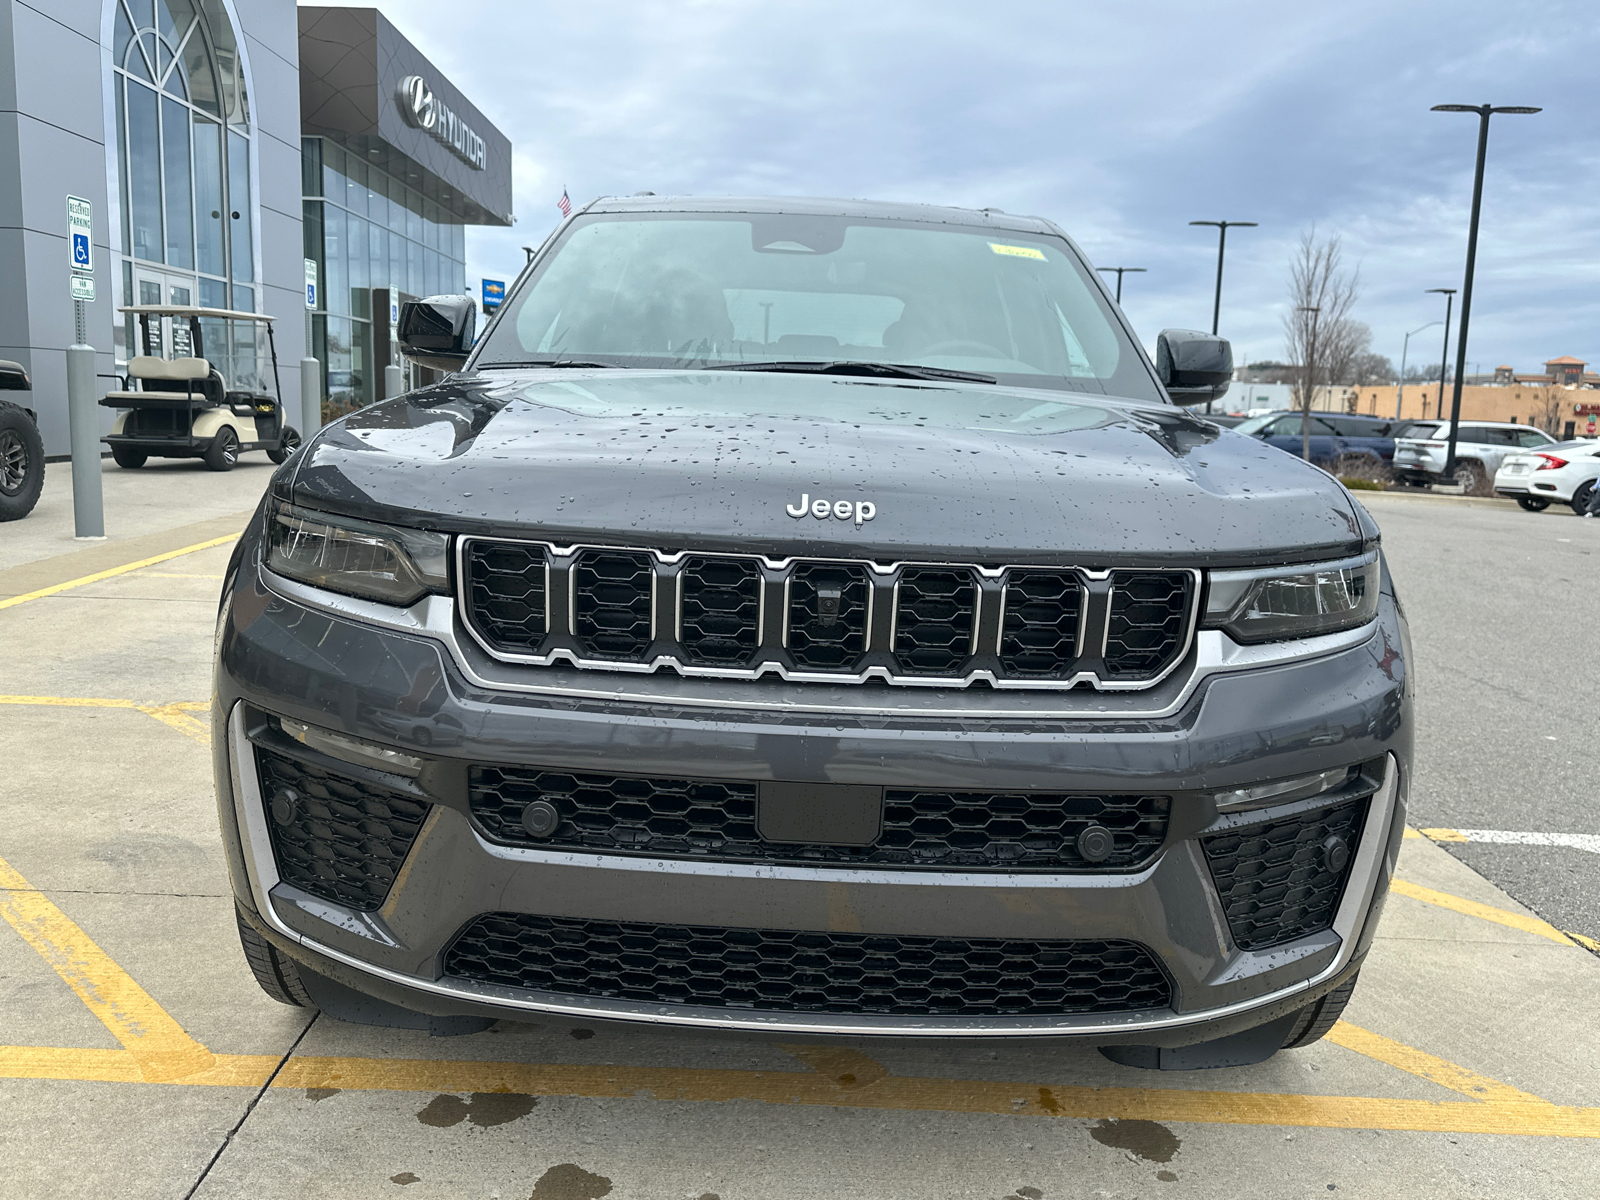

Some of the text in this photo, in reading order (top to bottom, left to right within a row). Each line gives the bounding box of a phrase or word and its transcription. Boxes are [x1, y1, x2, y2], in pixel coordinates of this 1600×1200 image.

[437, 99, 487, 171] HYUNDAI
[69, 203, 90, 217] RESERVED
[69, 215, 91, 229] PARKING
[79, 280, 87, 288] VAN
[72, 287, 94, 297] ACCESSIBLE
[786, 493, 877, 525] Jeep
